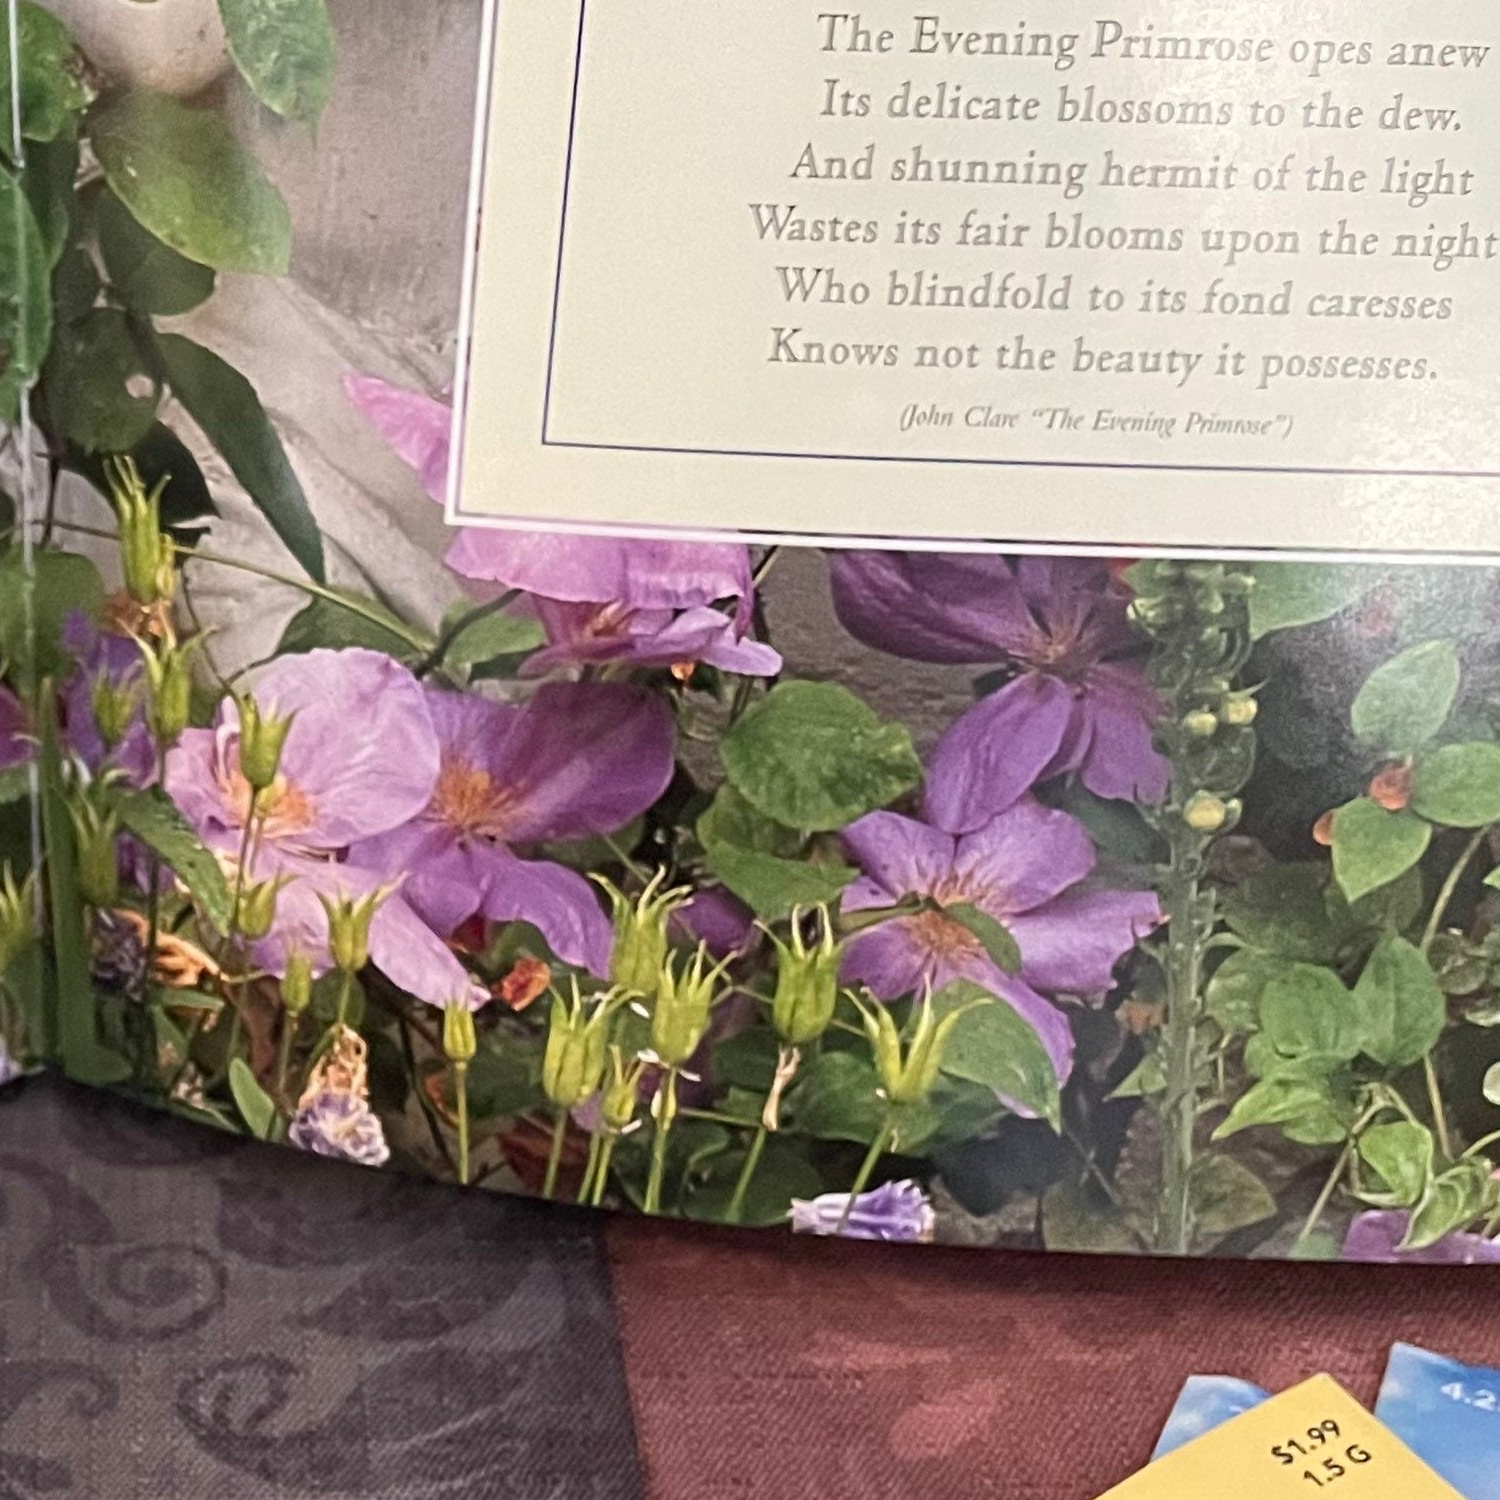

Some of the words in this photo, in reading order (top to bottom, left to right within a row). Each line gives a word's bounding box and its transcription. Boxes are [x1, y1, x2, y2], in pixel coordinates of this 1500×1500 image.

[816, 13, 895, 54] The
[908, 15, 1080, 72] Evening
[1089, 19, 1275, 63] Primrose
[1289, 39, 1373, 78] opes
[1386, 42, 1491, 69] anew
[819, 78, 871, 118] Its
[886, 79, 1041, 122] delicate
[1056, 84, 1234, 126] blossoms
[1249, 100, 1286, 127] to
[1302, 90, 1364, 129] the
[1378, 92, 1462, 132] dew.
[787, 141, 876, 181] And
[890, 144, 1088, 200] shunning
[1098, 149, 1239, 190] hermit
[1252, 153, 1293, 191] of
[1305, 157, 1368, 193] the
[1379, 156, 1475, 209] light
[748, 202, 879, 244] Wastes
[893, 210, 942, 246] its
[955, 209, 1031, 248] fair
[1044, 211, 1184, 252] blooms
[1201, 228, 1300, 268] upon
[1318, 219, 1379, 256] the
[1391, 223, 1500, 272] night
[774, 265, 871, 306] Who
[886, 269, 1072, 311] blindfold
[1088, 285, 1125, 312] to
[1137, 278, 1187, 314] its
[1201, 279, 1293, 316] fond
[1306, 293, 1453, 320] caresses
[766, 326, 899, 367] Knows
[913, 343, 980, 369] not
[996, 334, 1056, 372] the
[1072, 337, 1204, 388] beauty
[1214, 343, 1247, 377] it
[1255, 354, 1438, 390] possesses.
[899, 403, 954, 432] (John
[964, 405, 1020, 428] Clare
[1091, 409, 1177, 439] Evening
[1271, 1419, 1341, 1465] $1.99
[1303, 1458, 1346, 1487] 1.5
[1345, 1444, 1372, 1464] G
